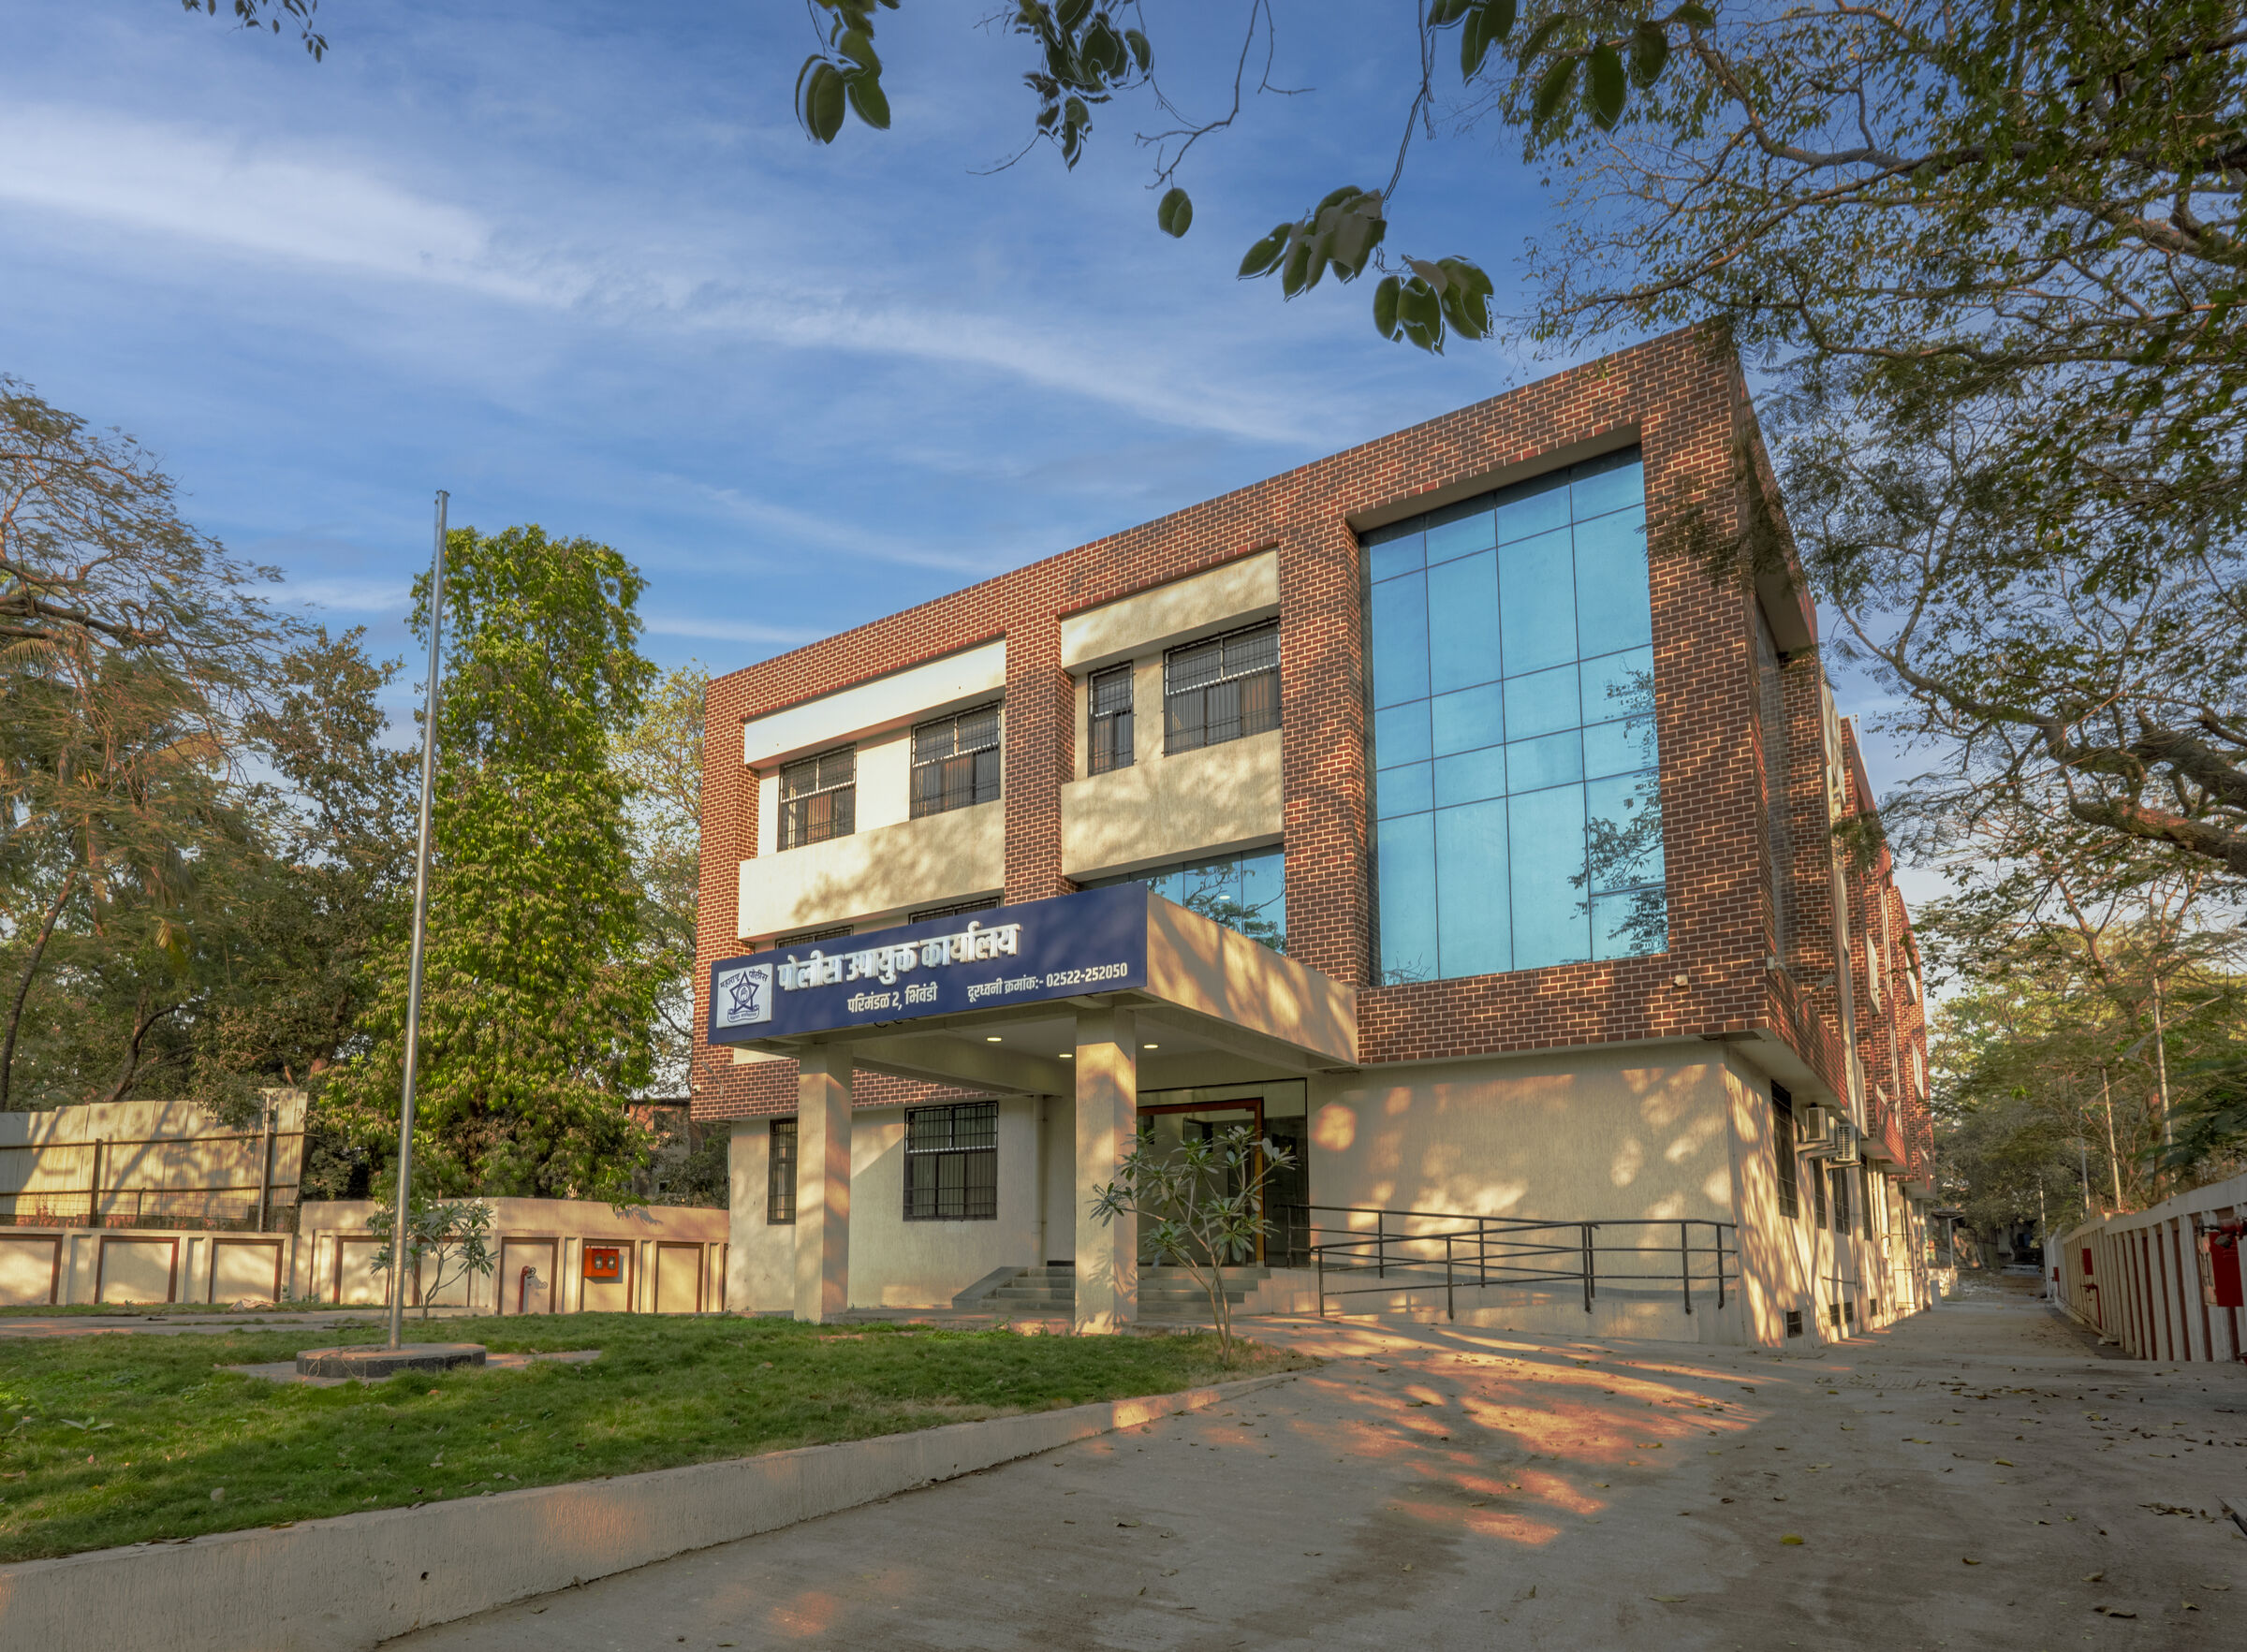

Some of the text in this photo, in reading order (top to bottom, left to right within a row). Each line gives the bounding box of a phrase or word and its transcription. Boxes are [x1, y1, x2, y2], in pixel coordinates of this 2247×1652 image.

[777, 950, 844, 992] पोलीस
[919, 920, 1021, 968] कार्यालय
[846, 981, 938, 1013] परिमंडळ 2, भिवंडी
[967, 977, 1003, 1002] दूरध्वनी
[1046, 962, 1128, 988] 02522-252050
